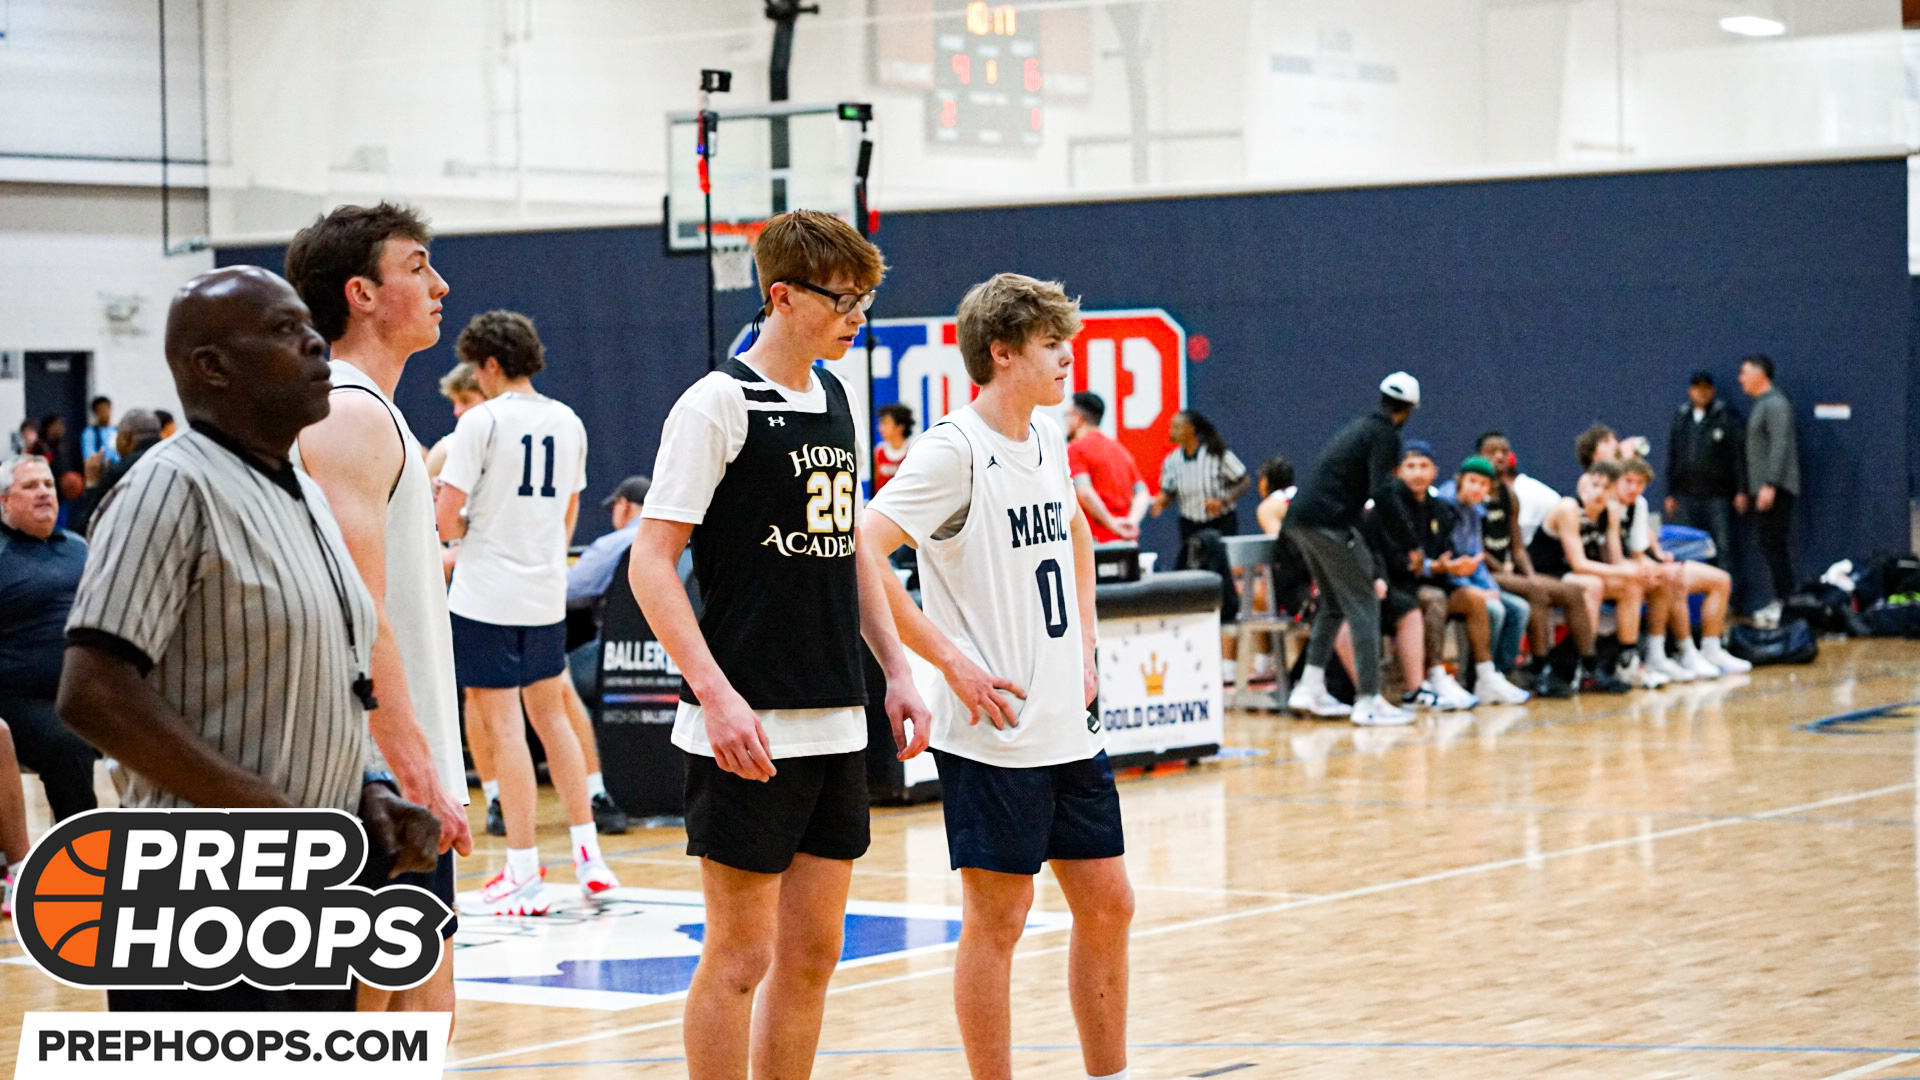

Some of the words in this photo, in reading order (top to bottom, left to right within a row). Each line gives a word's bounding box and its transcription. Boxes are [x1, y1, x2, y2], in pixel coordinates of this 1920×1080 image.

[518, 434, 555, 497] 11
[788, 444, 855, 477] HOOPS
[806, 471, 854, 533] 26
[761, 525, 855, 557] ACADEM
[1007, 502, 1067, 548] MAGIC
[1035, 559, 1068, 638] 0
[603, 641, 668, 671] BALLER
[1104, 707, 1142, 731] GOLD
[1147, 699, 1209, 726] CROWN
